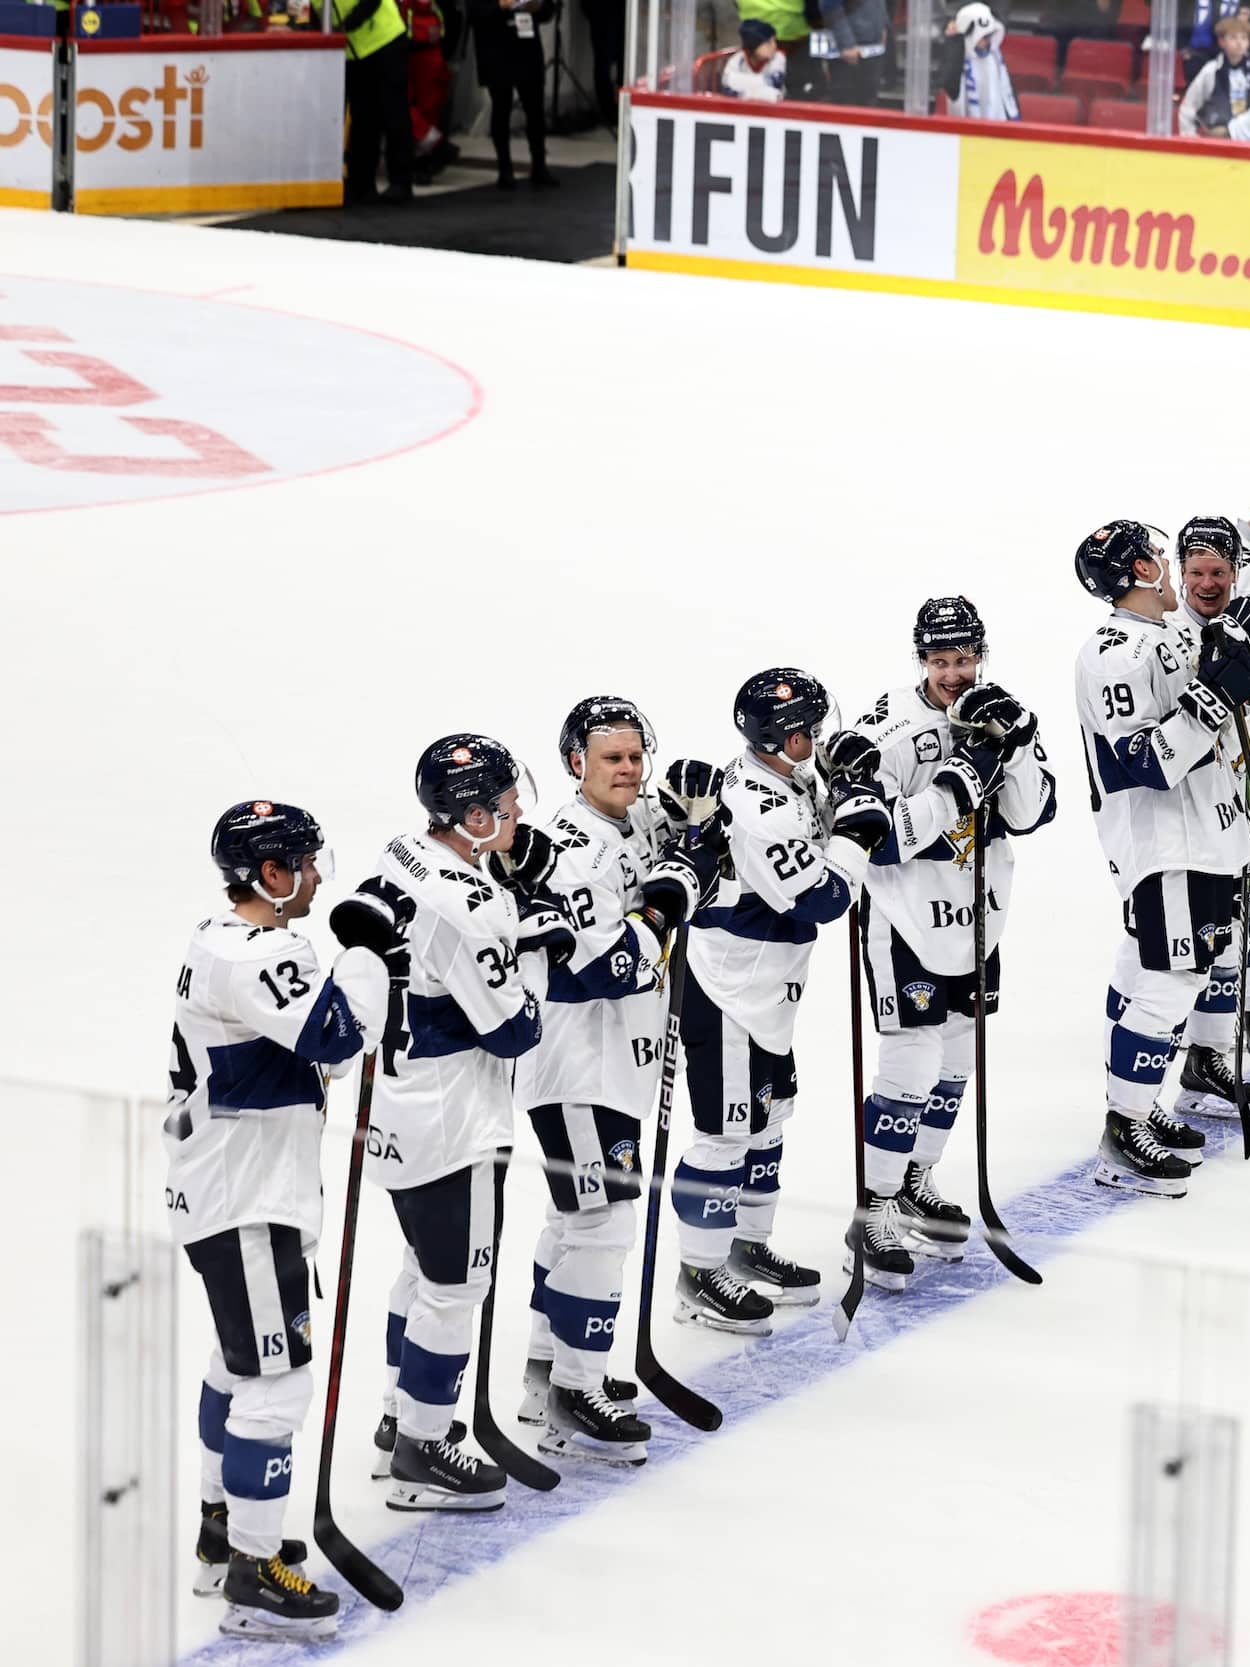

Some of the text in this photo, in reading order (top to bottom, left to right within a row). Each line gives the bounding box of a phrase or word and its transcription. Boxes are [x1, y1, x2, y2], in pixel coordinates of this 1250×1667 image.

[1101, 682, 1136, 720] 39
[874, 718, 911, 746] VEIKKAUS
[765, 838, 816, 882] 22
[1171, 937, 1191, 957] IS
[476, 946, 519, 990] 34
[258, 959, 311, 1011] 13
[878, 996, 895, 1017] IS
[725, 1102, 748, 1123] IS
[578, 1173, 600, 1195] IS
[470, 1246, 492, 1270] IS
[262, 1333, 284, 1358] IS
